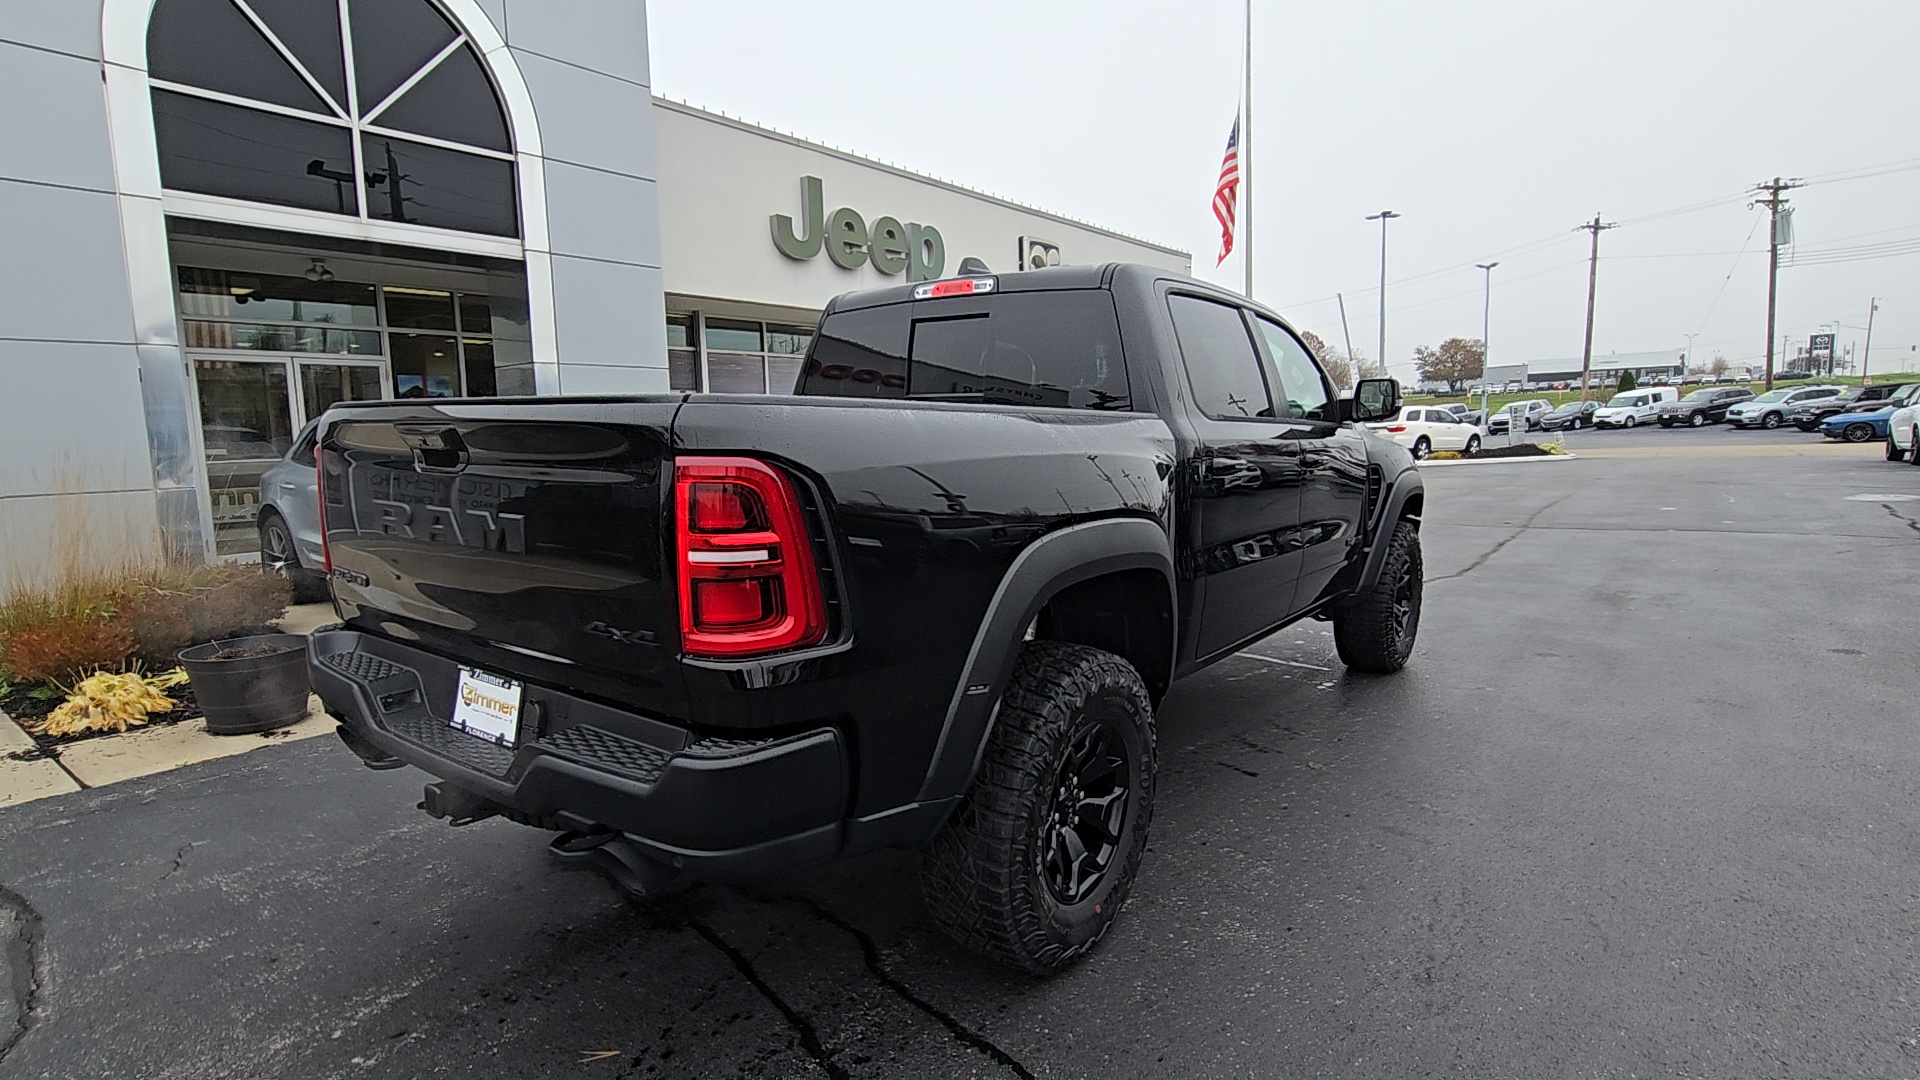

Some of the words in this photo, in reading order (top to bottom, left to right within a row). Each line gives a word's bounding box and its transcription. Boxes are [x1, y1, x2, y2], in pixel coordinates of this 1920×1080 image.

[769, 174, 946, 283] Jeep
[371, 499, 527, 554] RAM
[473, 667, 506, 688] Zimmer
[462, 684, 517, 716] Zimmer
